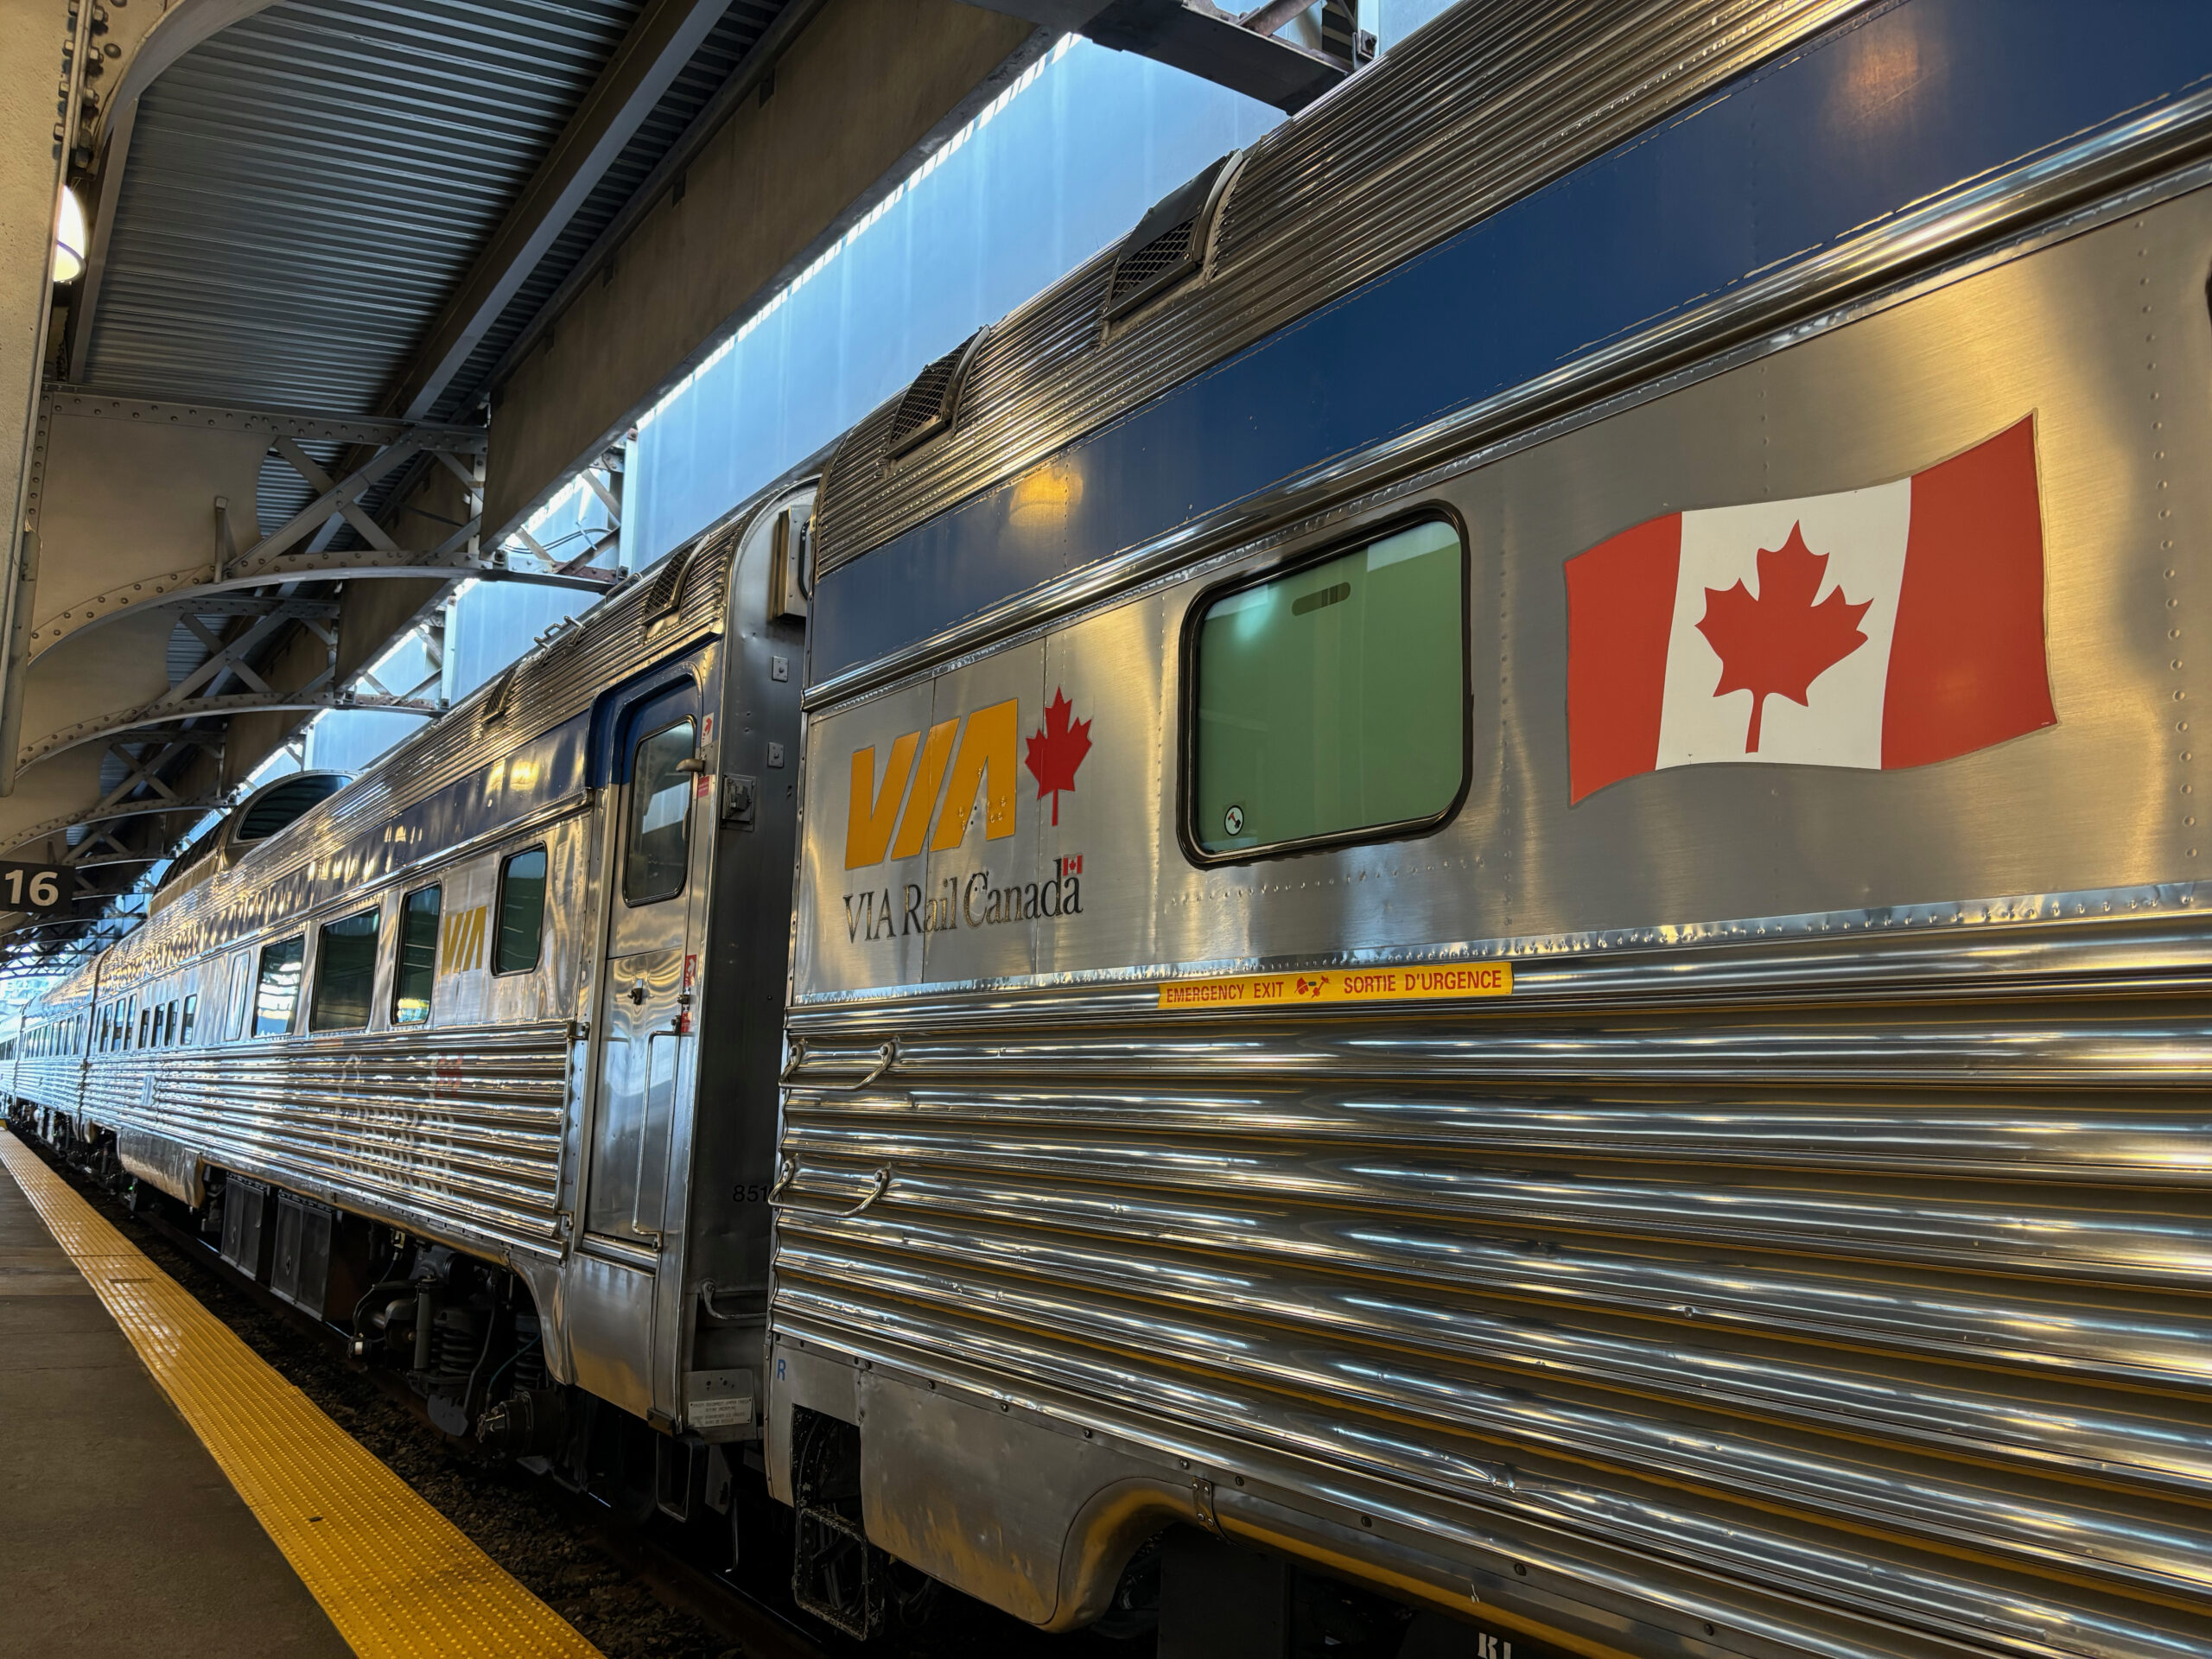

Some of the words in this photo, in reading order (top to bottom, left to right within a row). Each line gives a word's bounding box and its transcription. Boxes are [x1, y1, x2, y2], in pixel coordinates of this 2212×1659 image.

[845, 698, 1018, 870] VIA
[4, 869, 59, 906] 16
[843, 888, 896, 944] VIA
[903, 876, 957, 937] Rail
[963, 858, 1084, 928] Canada
[441, 906, 487, 976] VIA
[1166, 983, 1244, 1003] EMERGENCY
[1254, 981, 1284, 999] EXIT
[1344, 974, 1396, 994] SORTIE
[1405, 969, 1502, 991] D'URGENCE
[733, 1185, 774, 1203] 851
[777, 1359, 786, 1381] R
